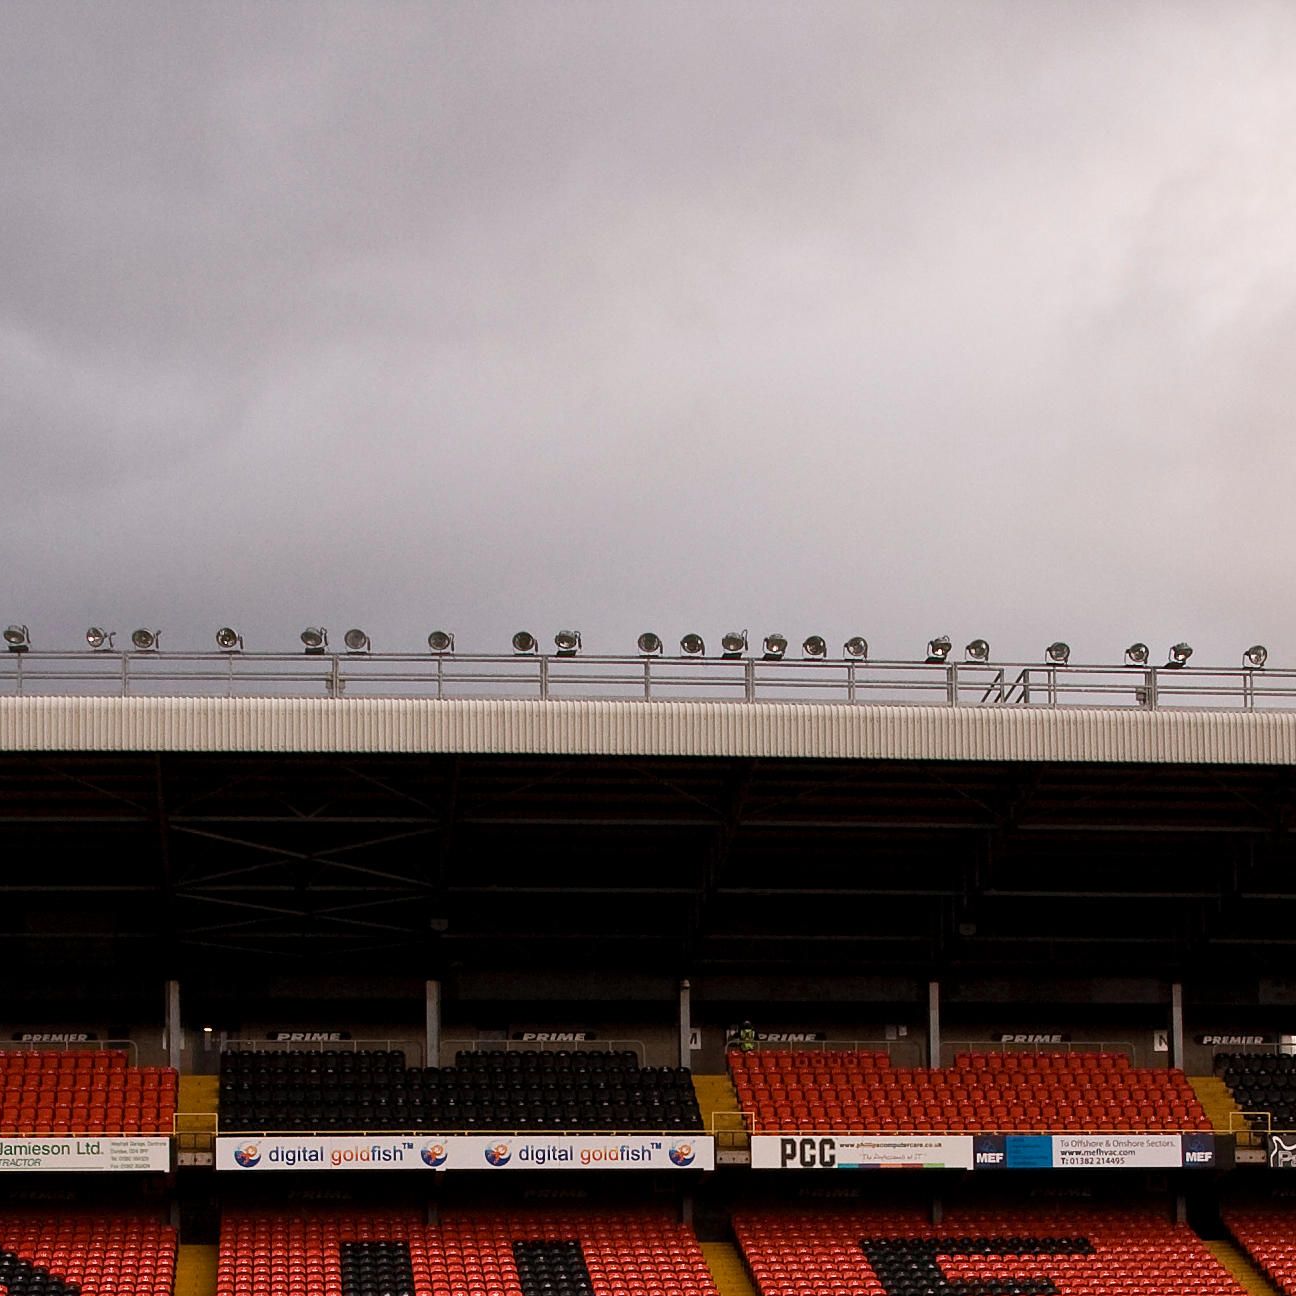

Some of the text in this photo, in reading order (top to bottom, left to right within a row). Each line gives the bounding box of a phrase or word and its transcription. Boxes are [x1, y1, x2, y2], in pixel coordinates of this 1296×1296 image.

[22, 1033, 88, 1042] PREMIER
[277, 1032, 341, 1041] PRIME
[523, 1032, 586, 1041] PRIME
[1001, 1034, 1062, 1043] PRIME
[1203, 1035, 1264, 1045] PREMIER
[77, 1140, 104, 1155] Ltd.
[1060, 1139, 1068, 1147] To
[1070, 1139, 1103, 1148] Offshore
[1112, 1139, 1144, 1147] Onshore
[1146, 1139, 1176, 1147] Sectors.
[269, 1145, 324, 1165] digital
[519, 1145, 573, 1165] digital
[781, 1138, 836, 1168] PCC
[976, 1152, 1003, 1164] MEF
[1185, 1152, 1213, 1163] MEF
[1069, 1157, 1094, 1165] 01382
[1096, 1157, 1125, 1165] 214495
